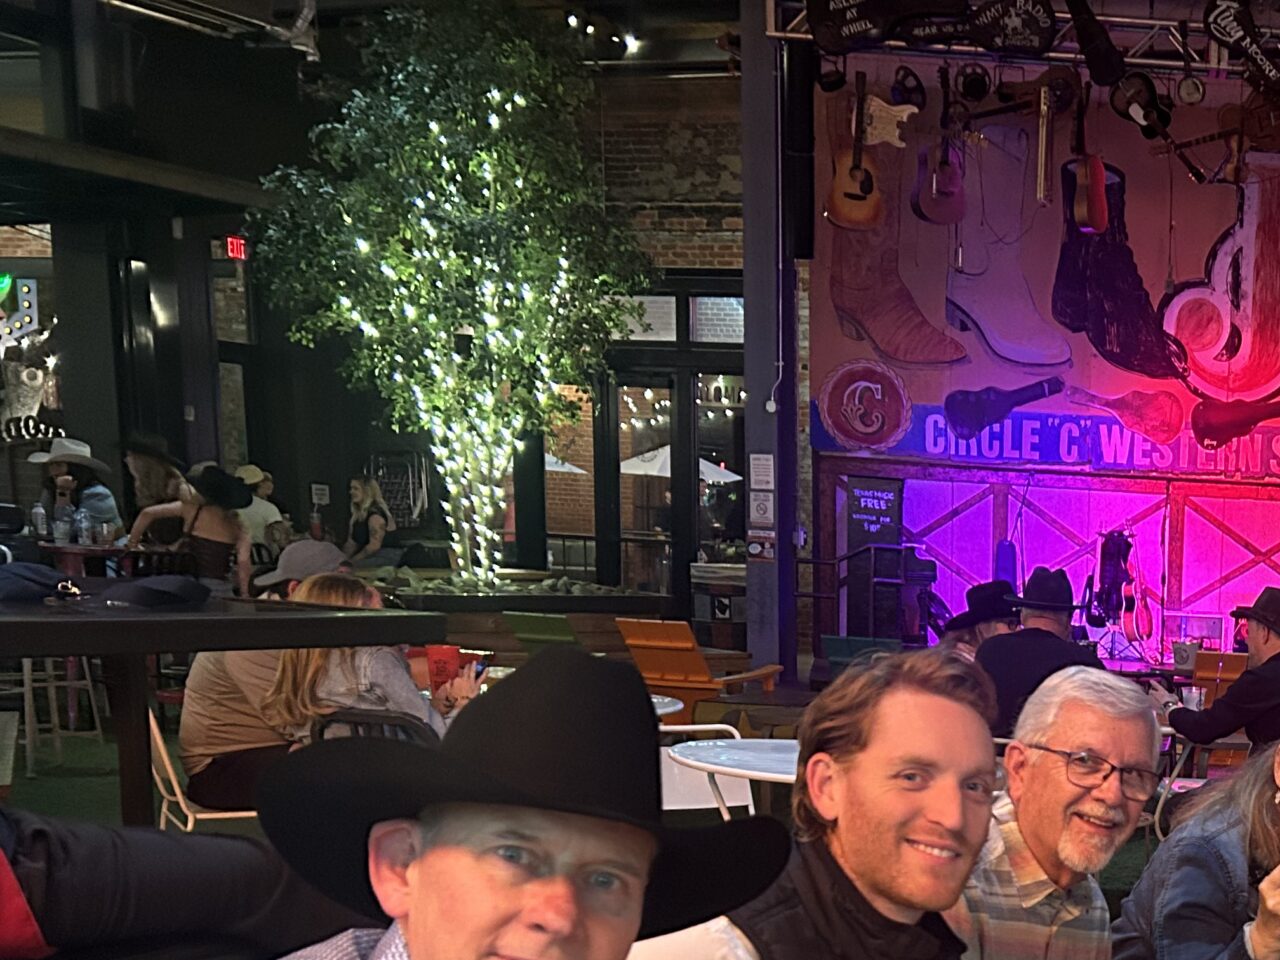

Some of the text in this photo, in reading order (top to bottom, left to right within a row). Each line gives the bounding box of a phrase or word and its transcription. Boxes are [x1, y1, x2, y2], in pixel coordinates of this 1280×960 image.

[1240, 36, 1280, 80] MOORE
[841, 381, 885, 434] C
[860, 498, 888, 510] FREE
